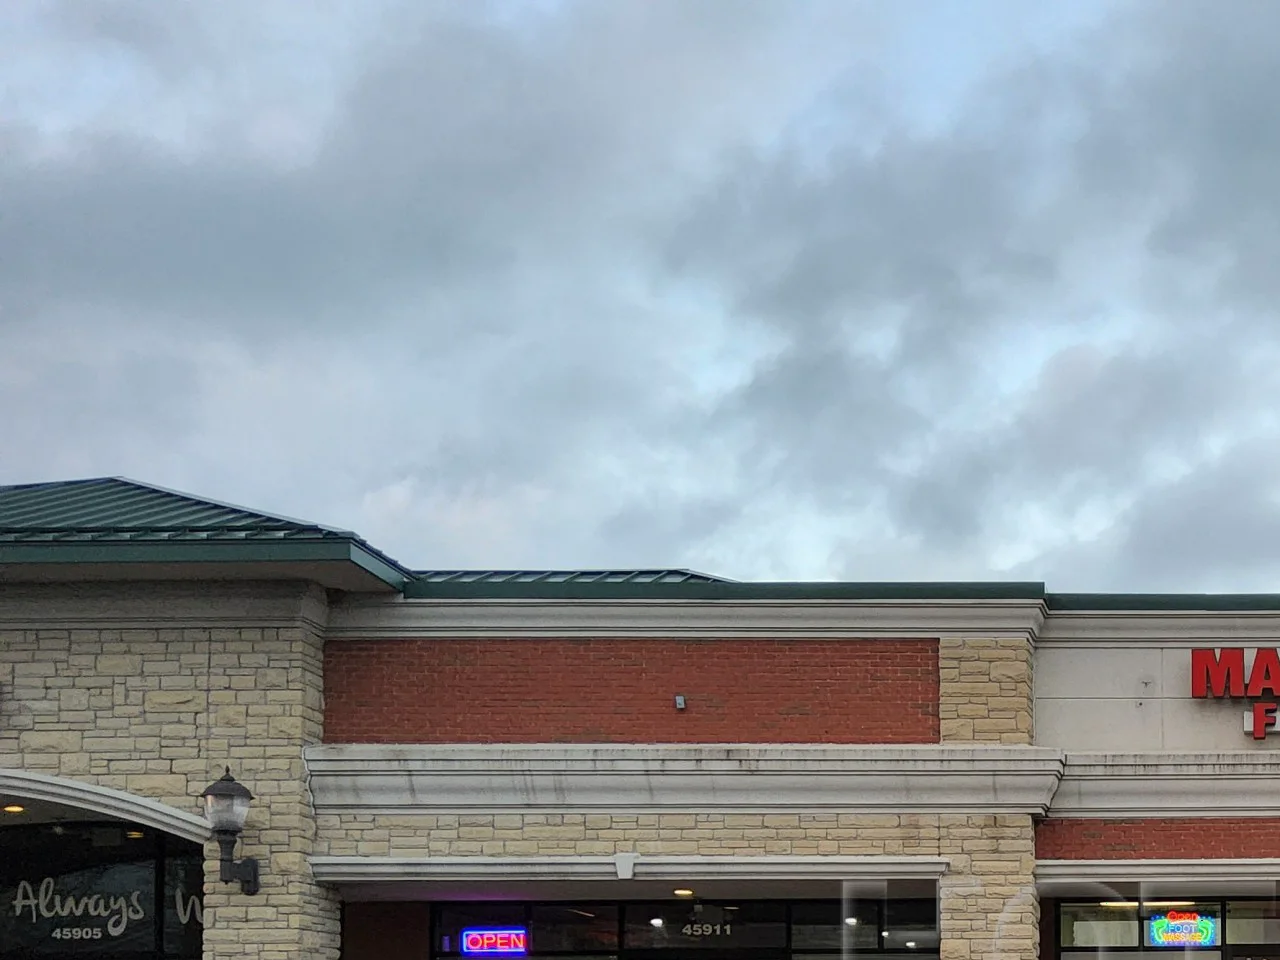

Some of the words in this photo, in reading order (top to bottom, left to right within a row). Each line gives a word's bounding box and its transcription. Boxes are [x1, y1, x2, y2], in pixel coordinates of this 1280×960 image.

[11, 877, 145, 937] Always
[1167, 911, 1198, 922] Open
[51, 928, 103, 940] 45905
[681, 923, 731, 936] 45911
[1168, 924, 1197, 933] FOOT
[467, 933, 525, 950] OPEN
[1163, 933, 1202, 942] MASSAGE
